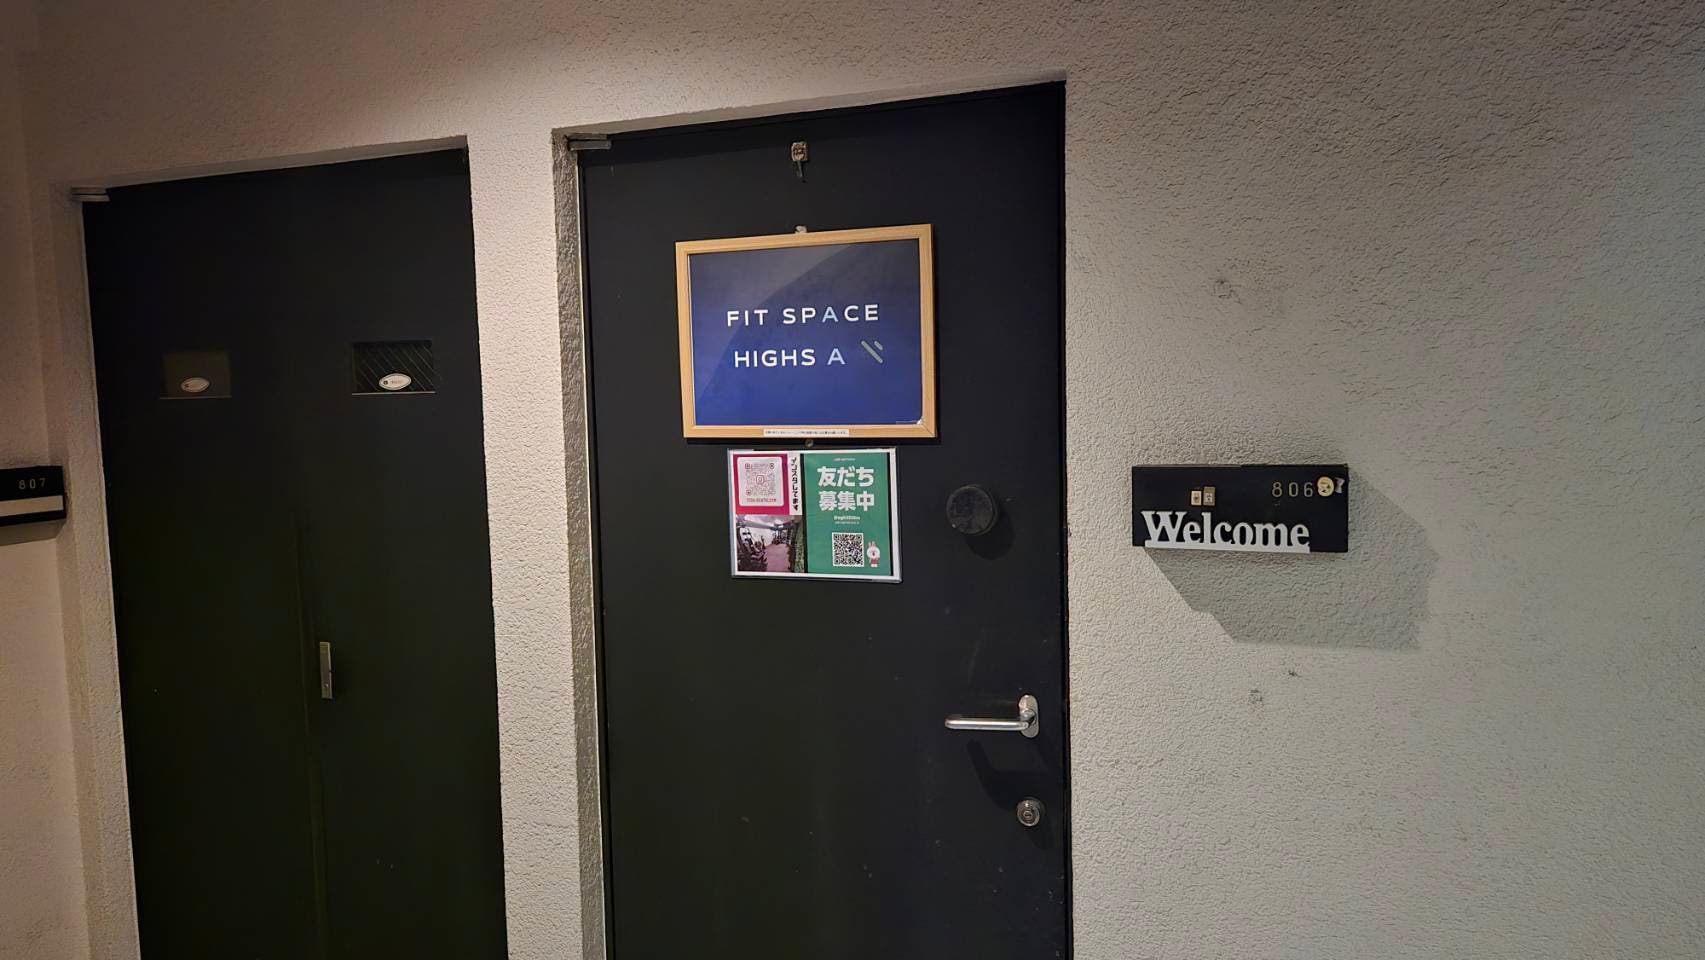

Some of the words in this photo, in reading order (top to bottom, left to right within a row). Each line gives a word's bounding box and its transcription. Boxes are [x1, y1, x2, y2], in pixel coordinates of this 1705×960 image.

[727, 309, 769, 327] FIT
[782, 304, 879, 325] SPACE
[734, 348, 816, 368] HIGHS
[827, 347, 846, 366] A
[18, 478, 46, 490] 807
[817, 466, 874, 488] 友だち
[1271, 481, 1314, 498] 806
[819, 491, 875, 512] 募集中
[1141, 510, 1310, 552] Welcome
